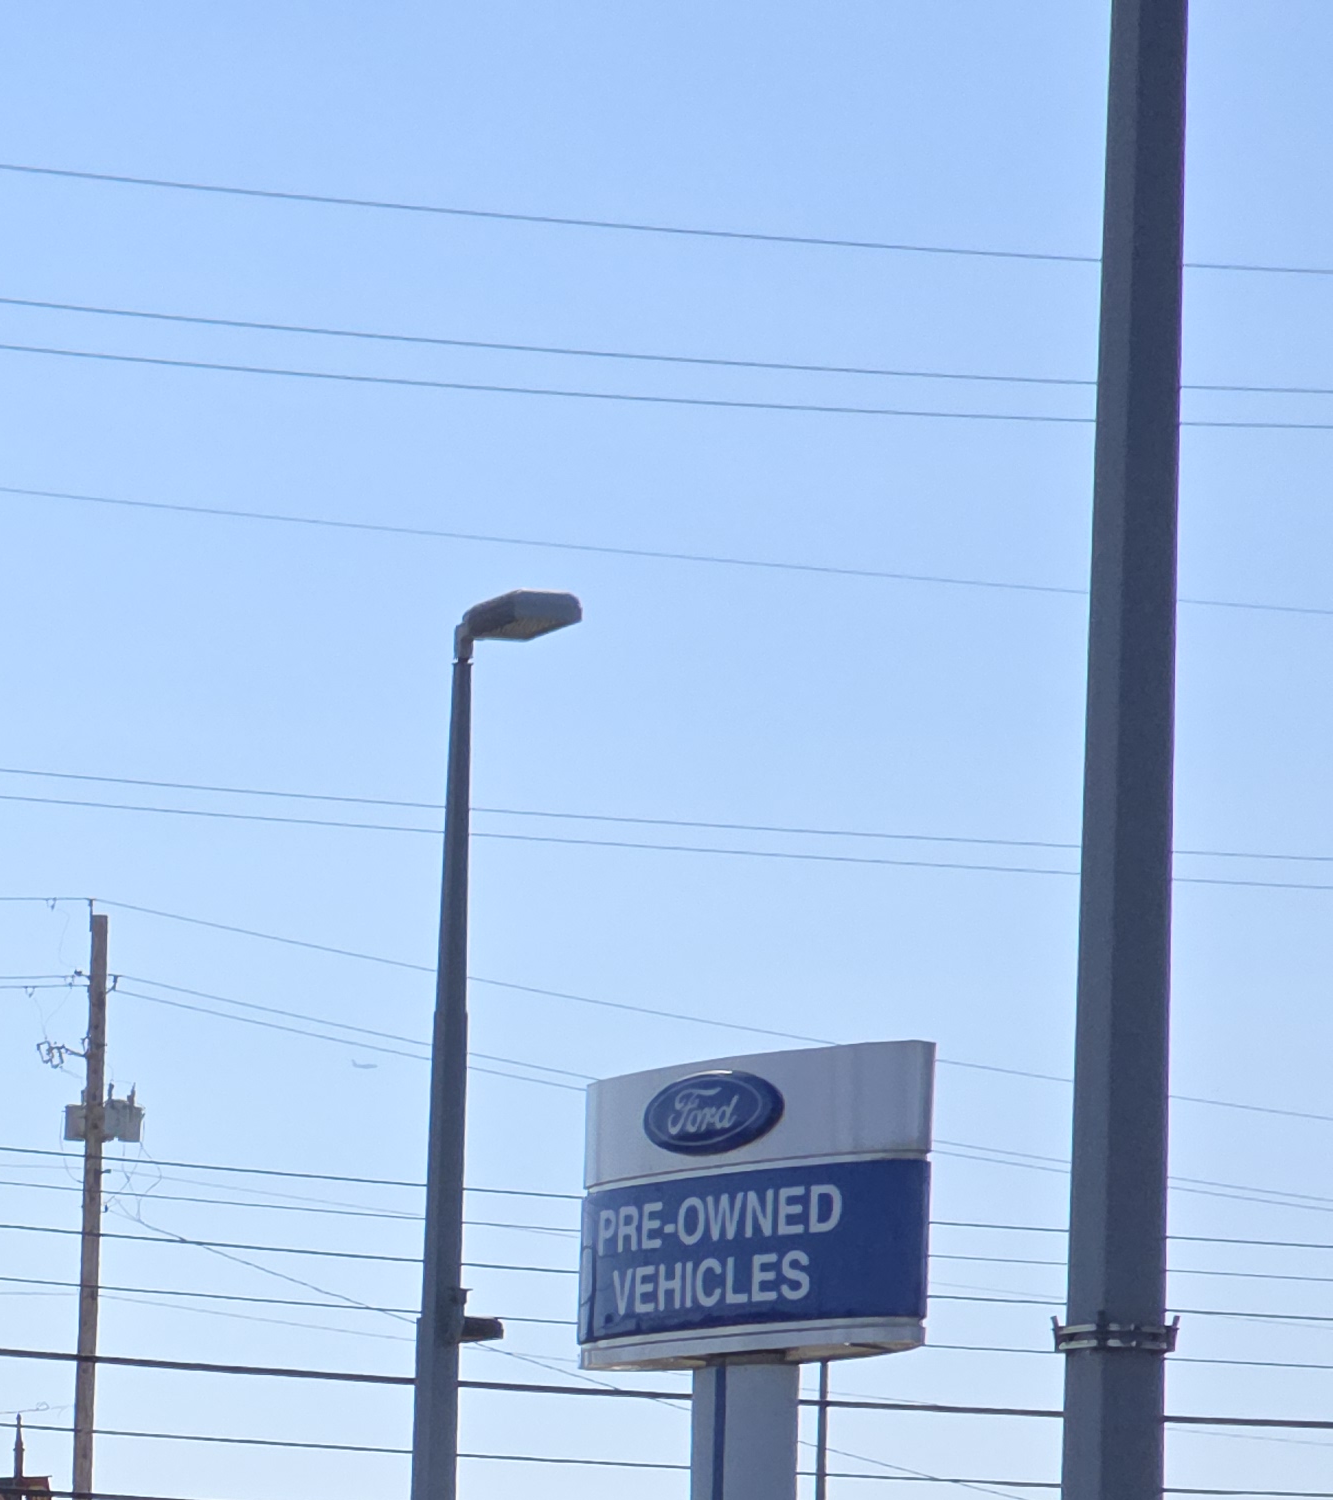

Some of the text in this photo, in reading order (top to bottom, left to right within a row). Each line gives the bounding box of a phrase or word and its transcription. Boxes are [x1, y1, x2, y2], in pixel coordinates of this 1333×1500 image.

[668, 1086, 739, 1135] Ford
[598, 1184, 843, 1257] PRE-OWNED
[613, 1250, 810, 1316] VEHICLES
